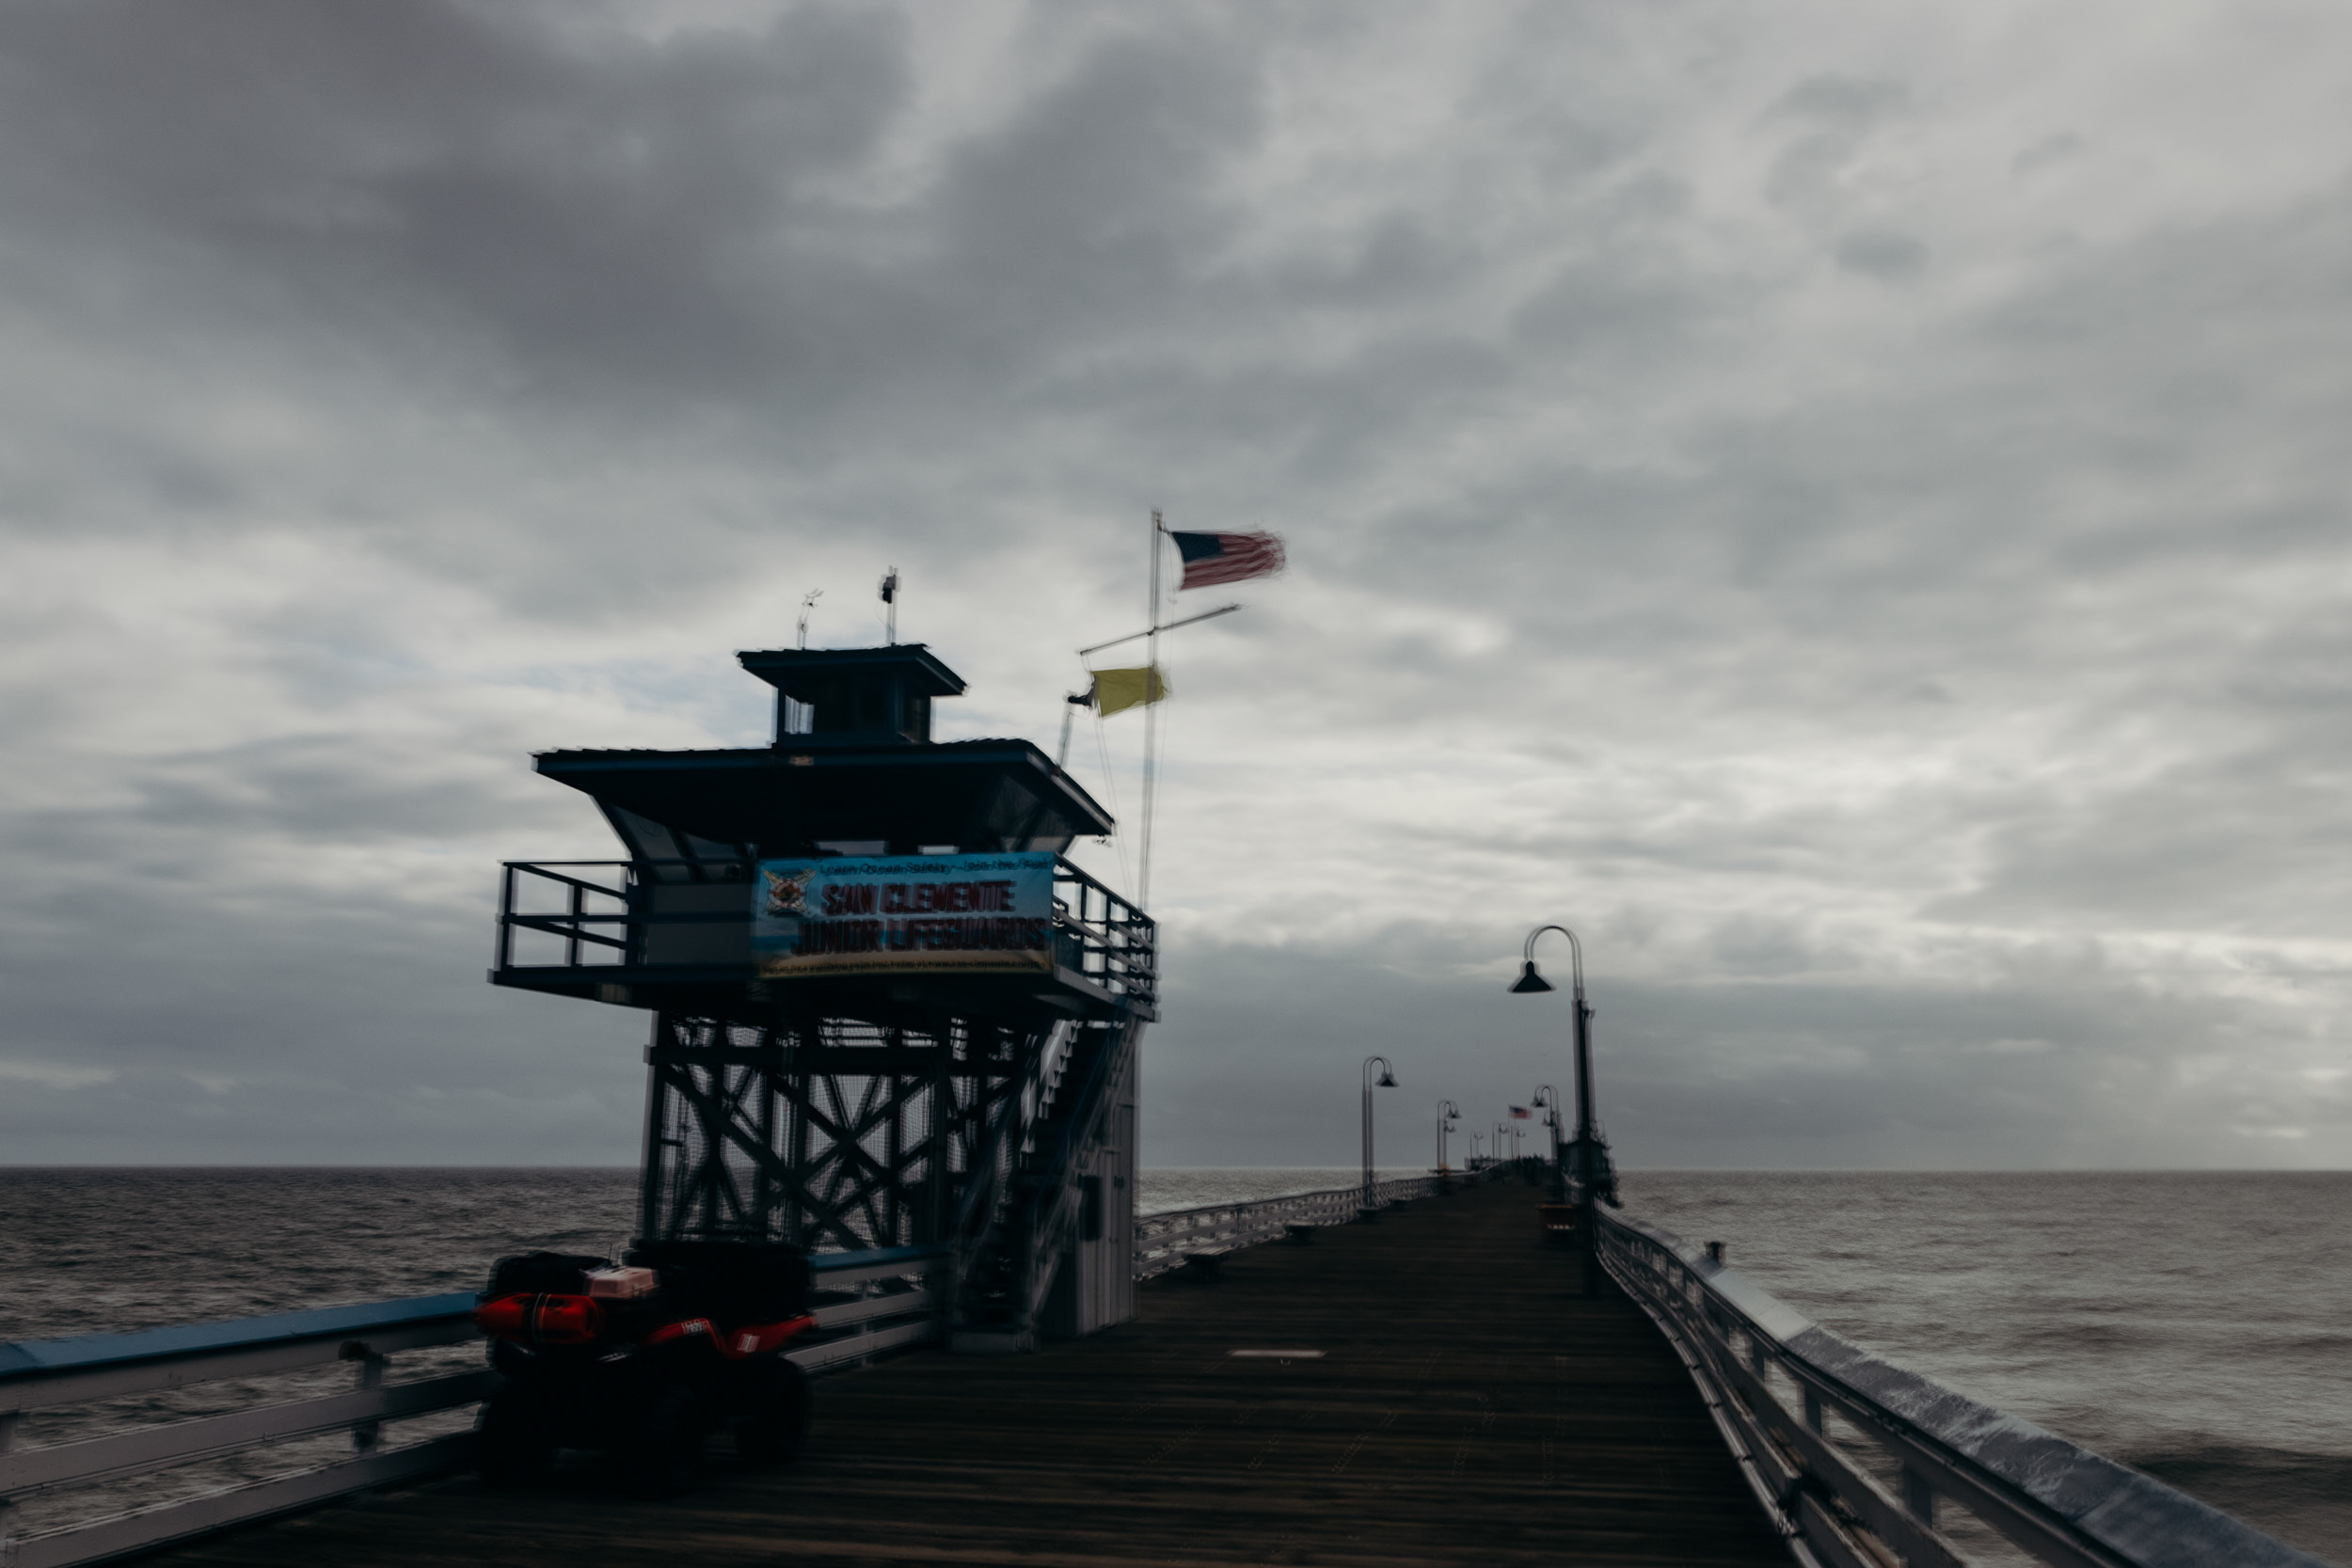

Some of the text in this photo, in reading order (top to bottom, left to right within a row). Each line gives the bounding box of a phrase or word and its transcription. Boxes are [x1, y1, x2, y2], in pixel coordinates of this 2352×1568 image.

[821, 880, 1016, 916] SAN CLEMENTE
[790, 917, 1048, 957] JUNIOR LIFEGUARDS
